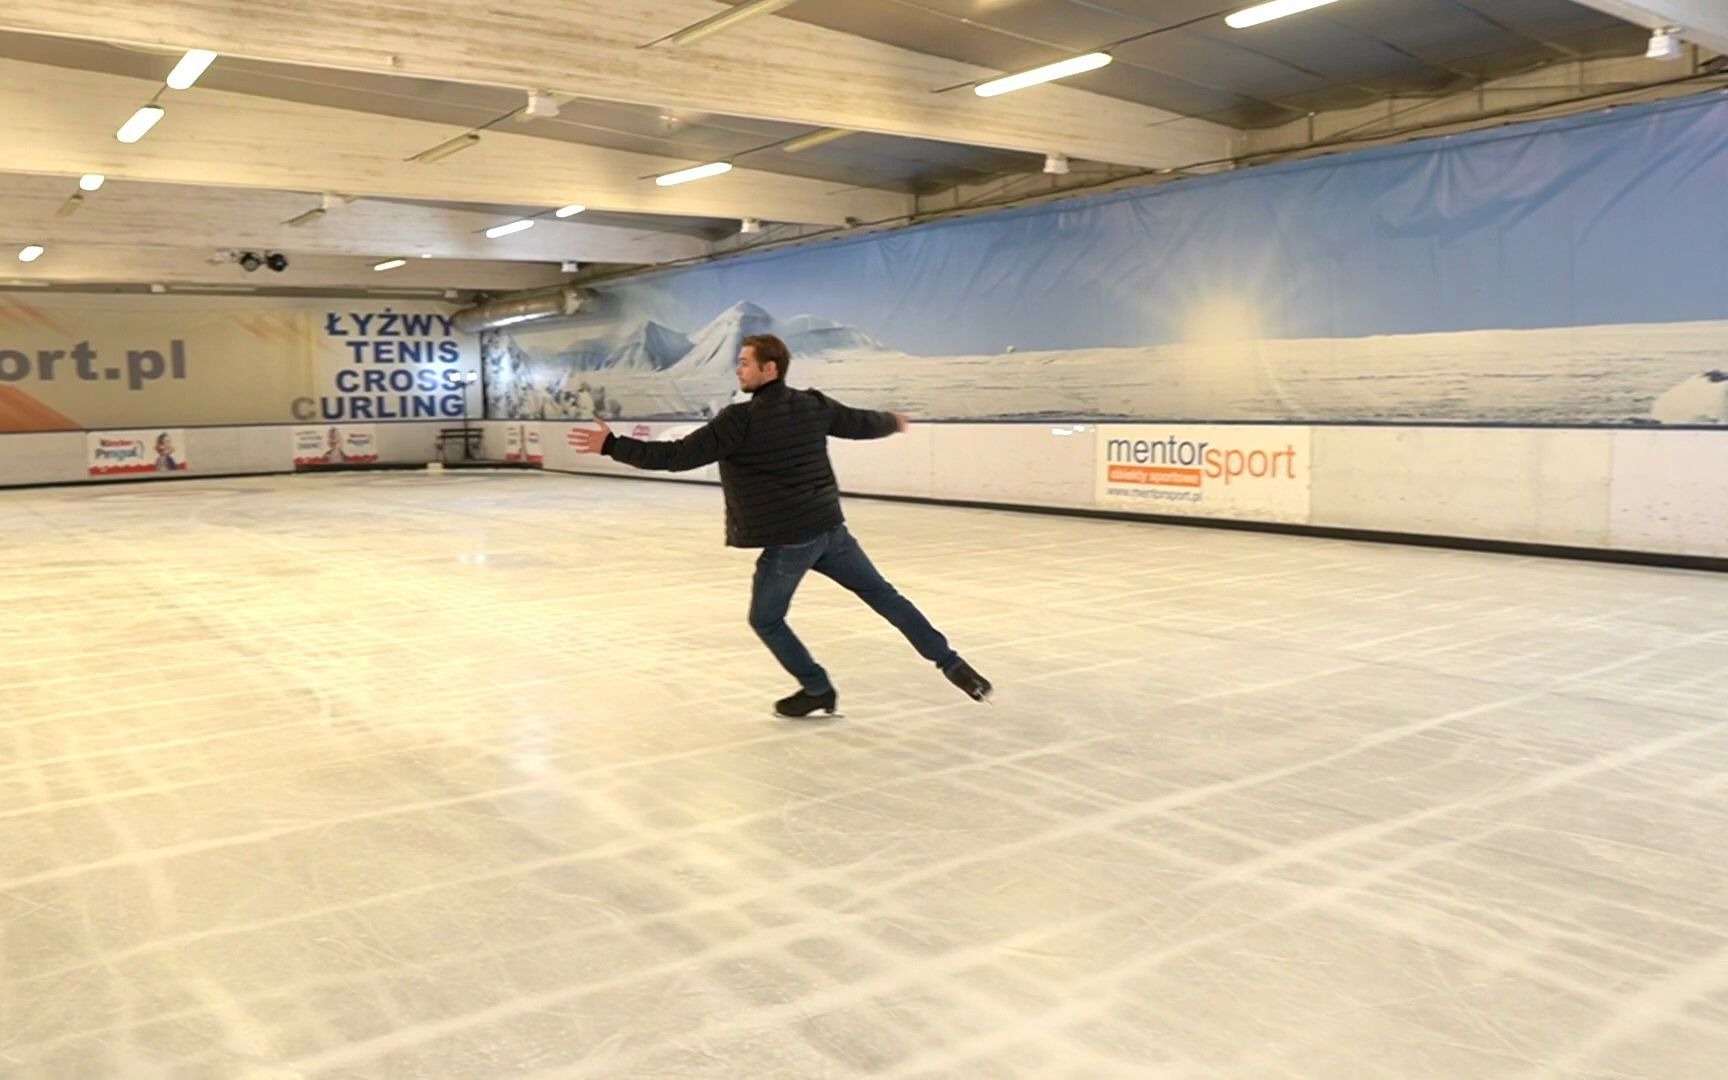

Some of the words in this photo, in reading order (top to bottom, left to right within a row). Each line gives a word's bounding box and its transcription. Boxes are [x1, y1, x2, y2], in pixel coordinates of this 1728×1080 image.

[325, 308, 453, 336] ŁYŻWY
[346, 341, 459, 363] TENIS
[0, 340, 186, 390] ort.pl
[335, 369, 463, 393] CROSS
[291, 395, 464, 420] CURLING
